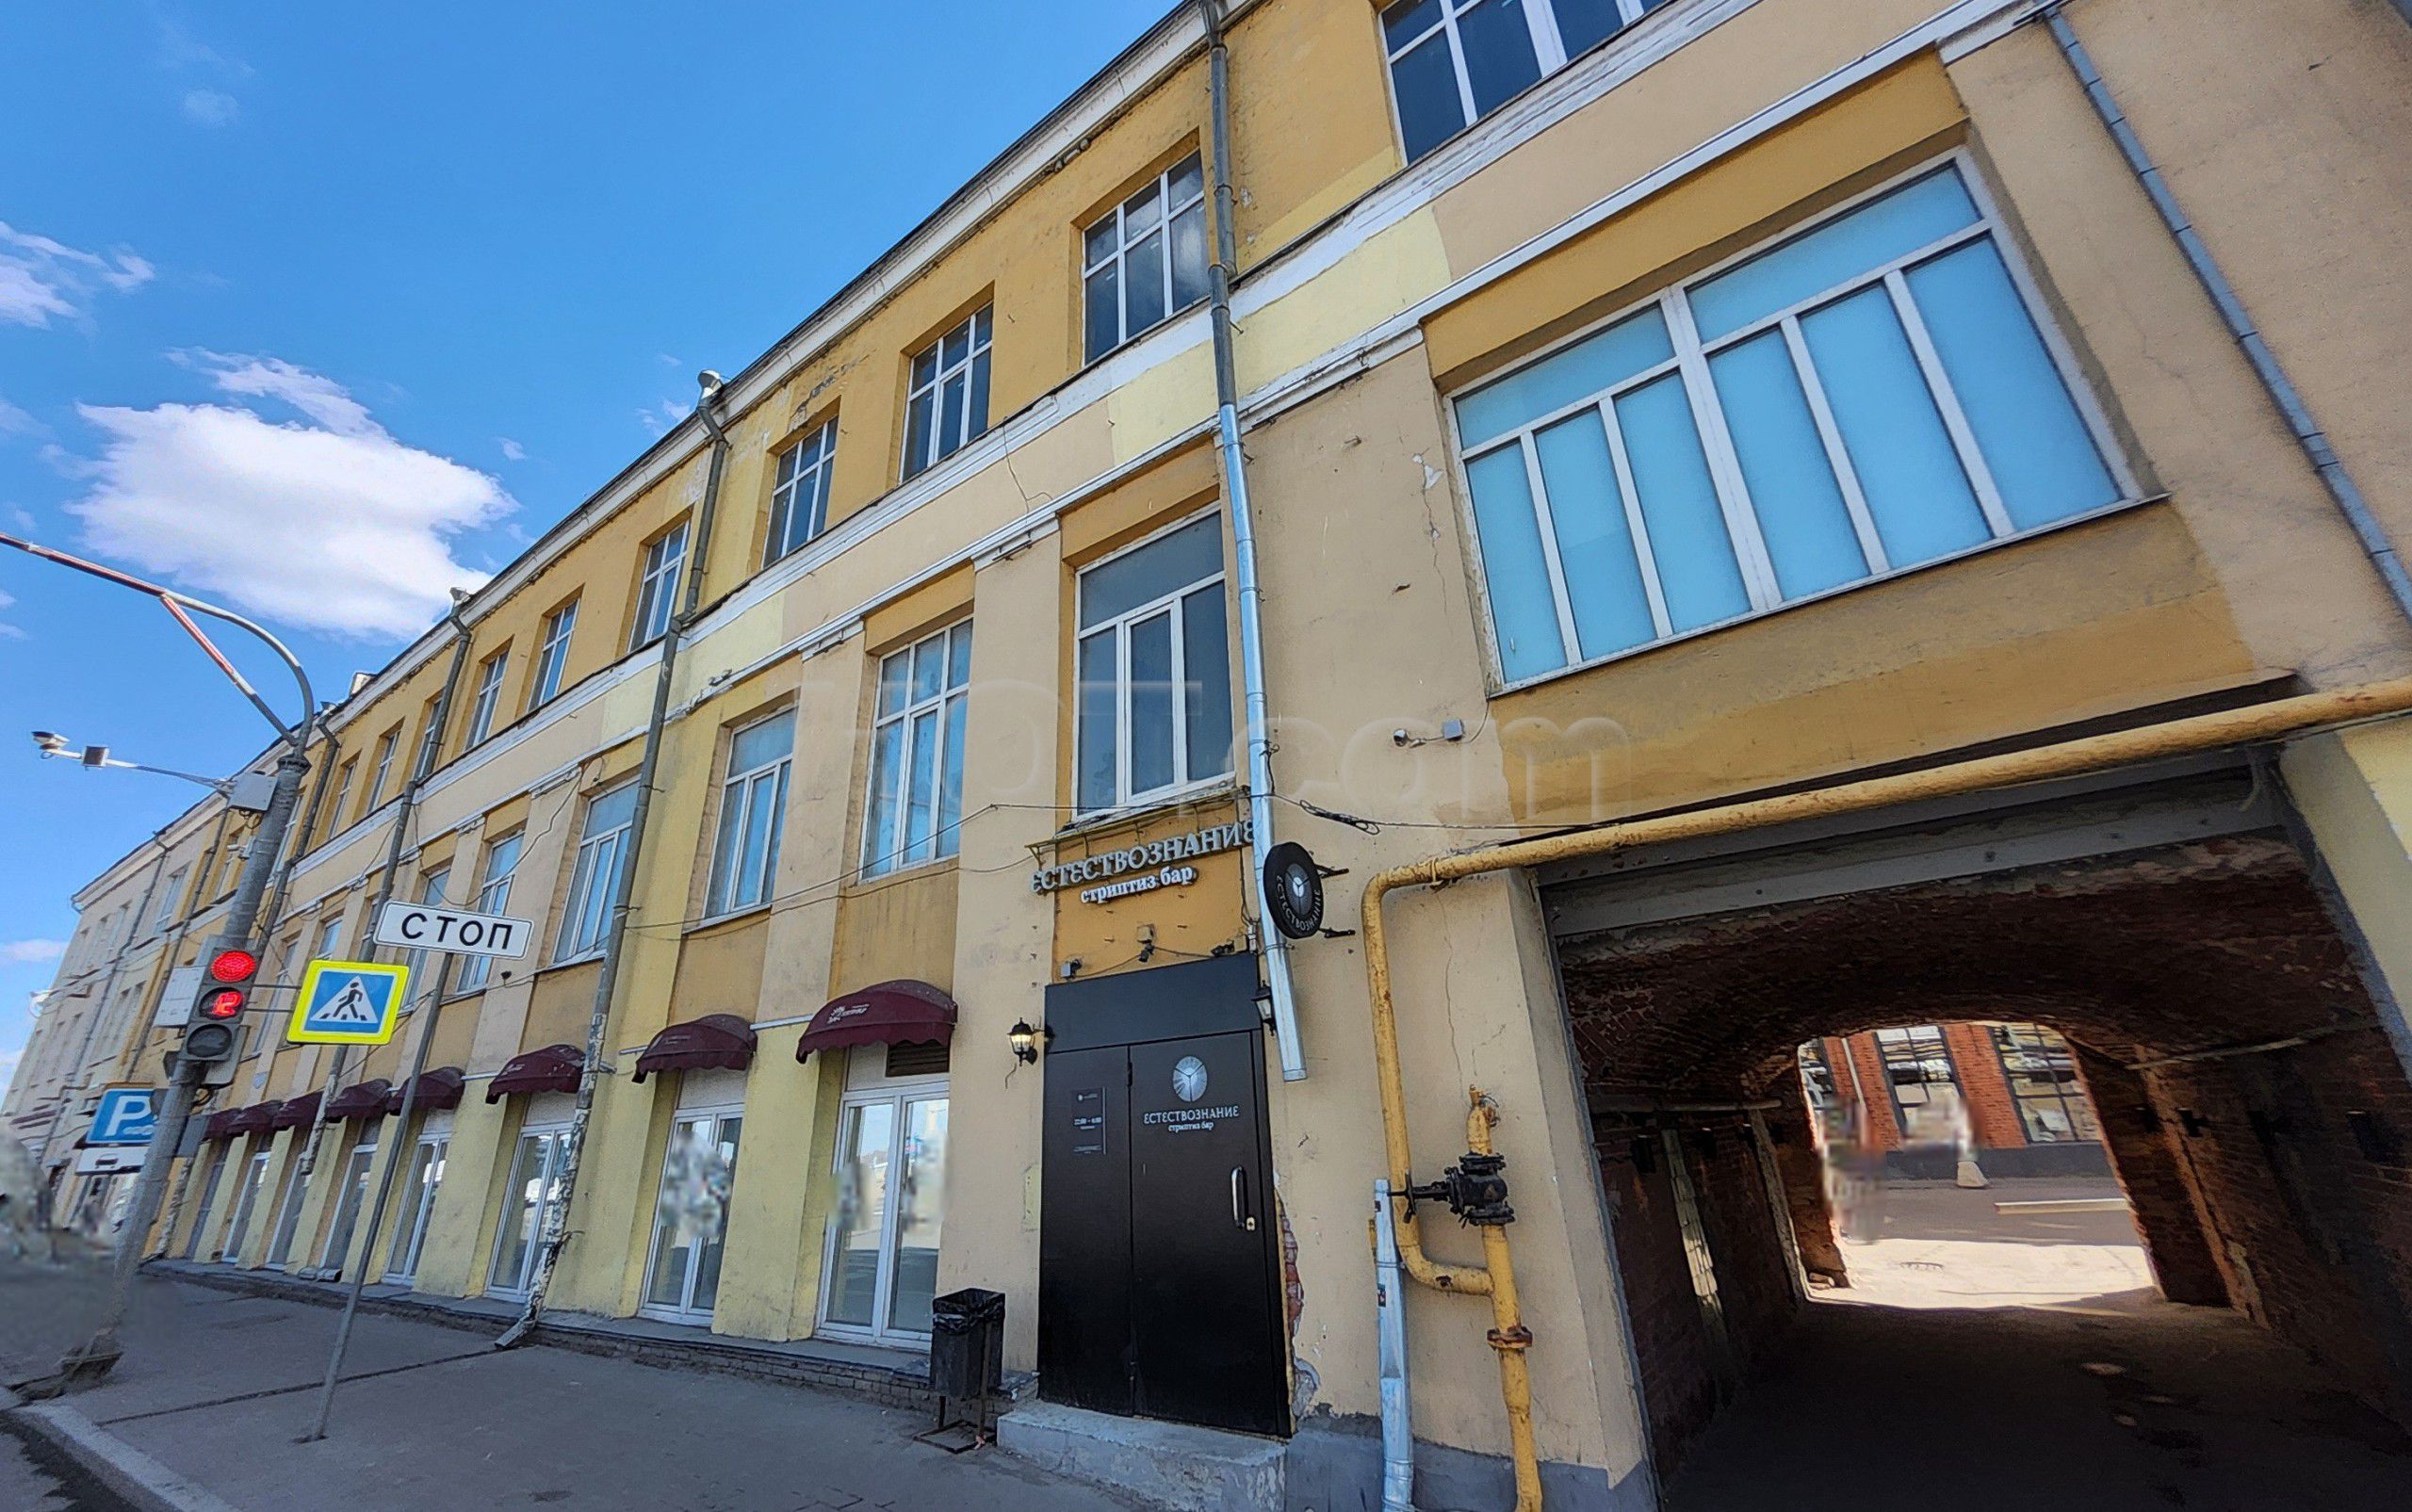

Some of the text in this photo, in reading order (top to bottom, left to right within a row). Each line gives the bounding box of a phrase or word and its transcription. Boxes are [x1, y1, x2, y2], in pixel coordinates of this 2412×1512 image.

[1080, 864, 1195, 904] стриптиз бар
[400, 912, 513, 951] СТОП
[1143, 1105, 1240, 1124] ЕСТЕСТВОЗНАНИЕ
